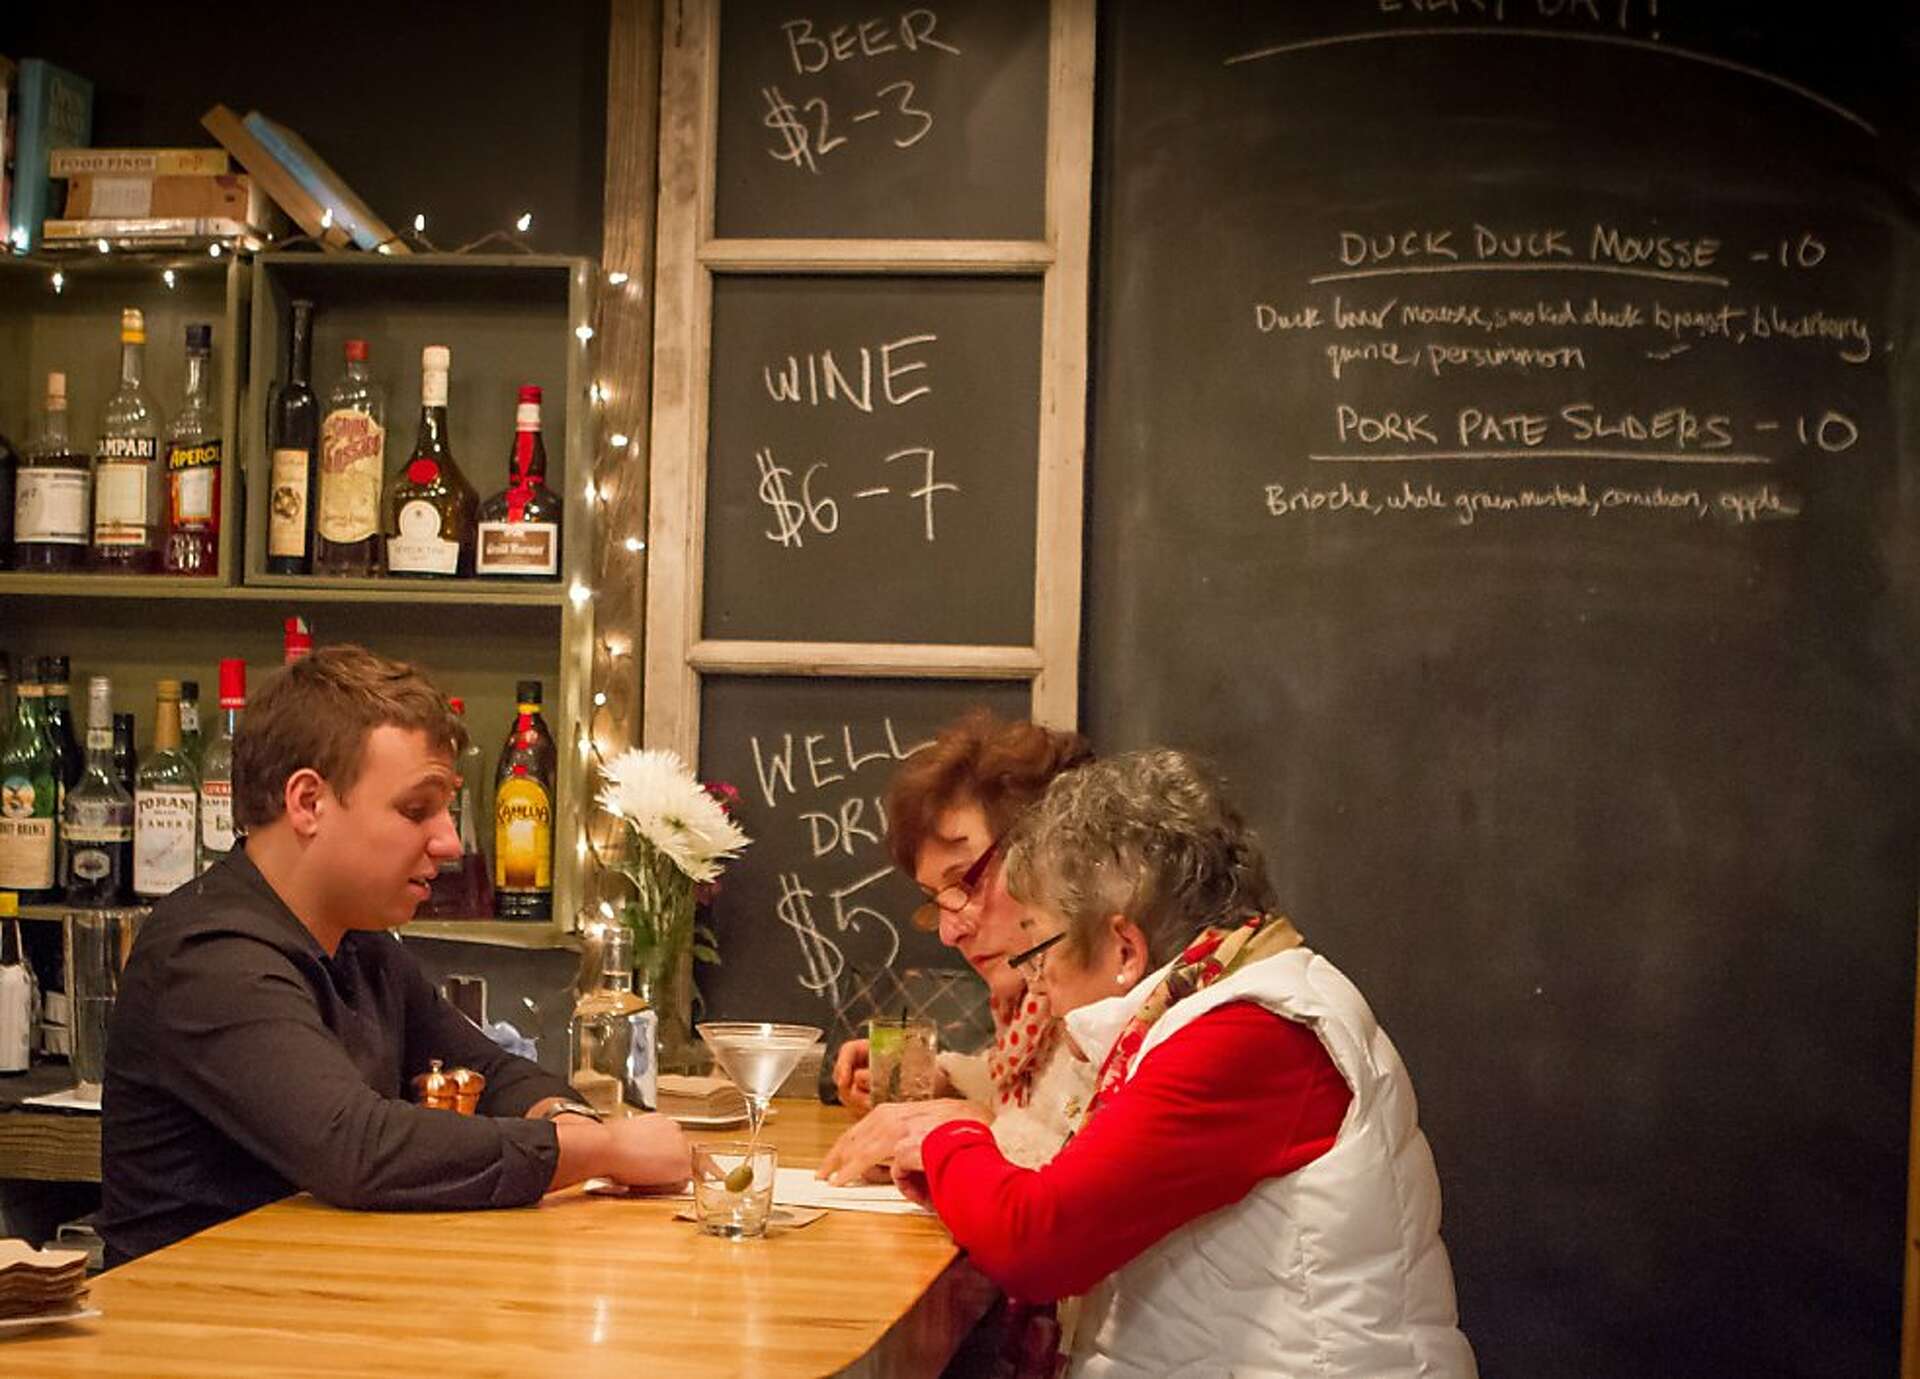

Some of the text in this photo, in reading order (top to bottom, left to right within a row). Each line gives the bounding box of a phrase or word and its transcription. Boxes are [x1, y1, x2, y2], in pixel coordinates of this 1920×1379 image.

[782, 9, 961, 74] BEER
[1340, 231, 1458, 266] DUCK
[1474, 224, 1573, 259] DUCK
[1255, 304, 1324, 331] Duck
[1584, 299, 1643, 329] duck
[765, 335, 938, 413] WINE
[1337, 405, 1438, 444] PORK
[1458, 409, 1549, 446] PATE
[1562, 404, 1733, 449] SLIDERS
[756, 447, 961, 548] $6-7
[1265, 482, 1383, 516] Brioche,
[1387, 482, 1448, 509] whole
[752, 717, 938, 807] WELL
[800, 798, 889, 858] DRI
[777, 865, 900, 1008] $5
